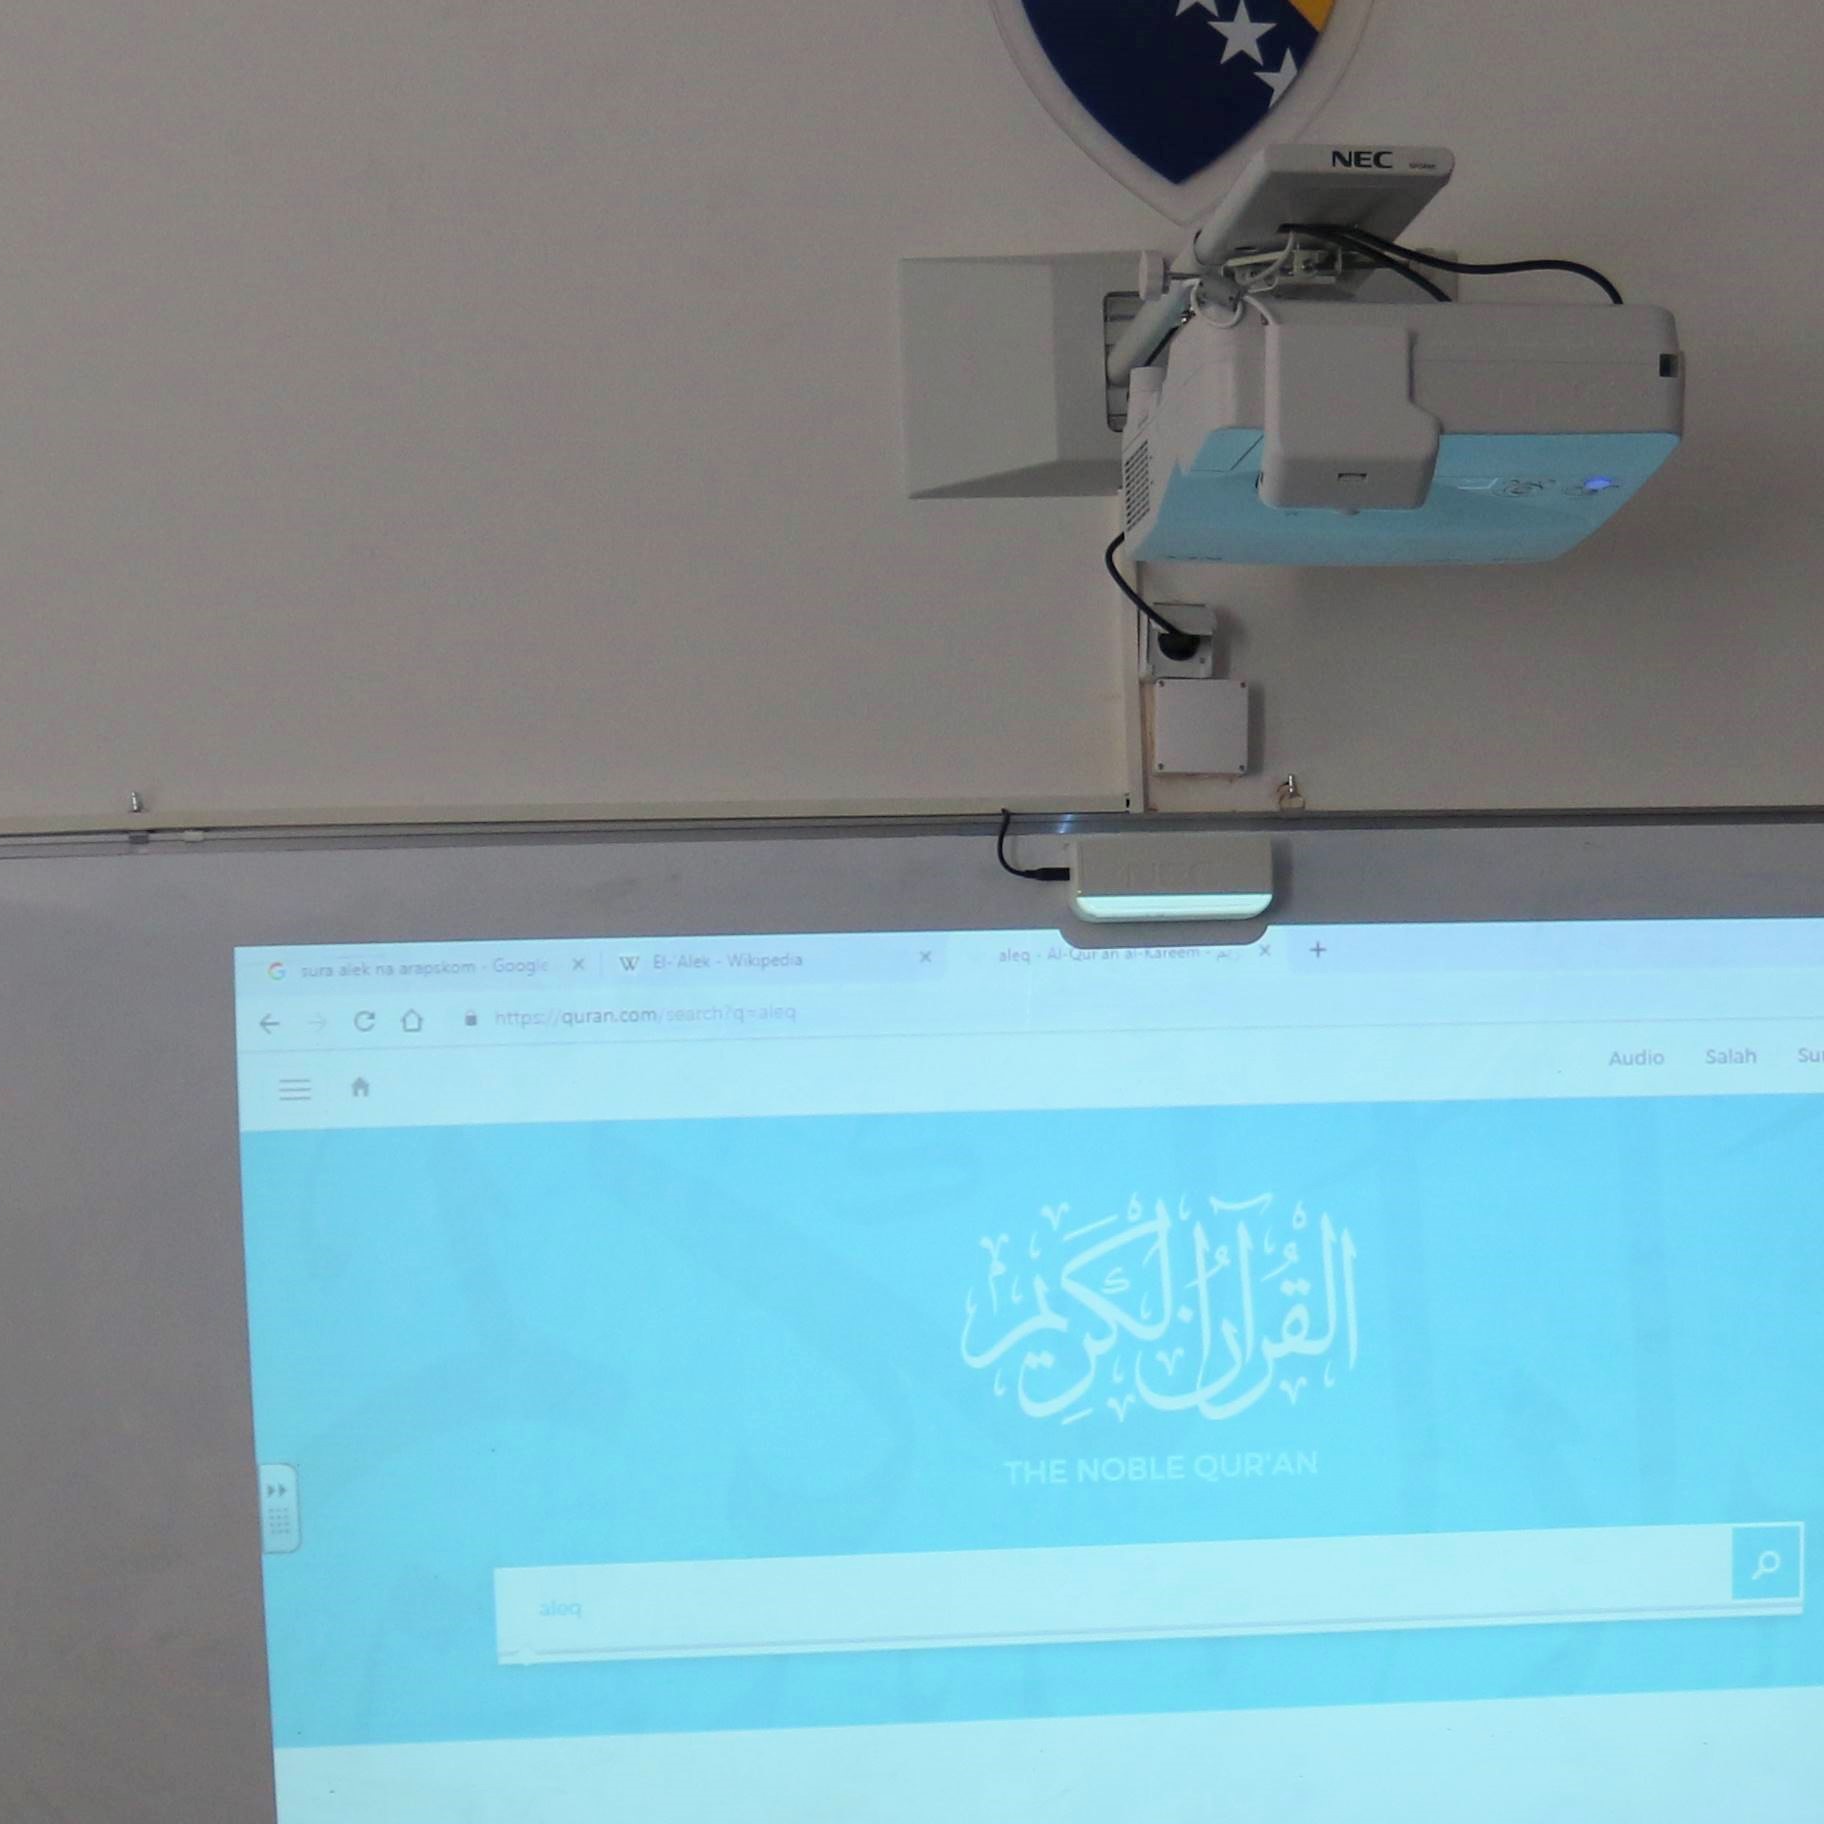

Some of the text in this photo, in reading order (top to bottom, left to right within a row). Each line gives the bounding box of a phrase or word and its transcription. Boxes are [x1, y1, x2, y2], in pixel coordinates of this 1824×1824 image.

[1332, 151, 1393, 168] NEC
[728, 951, 803, 970] Wikipedia
[999, 948, 1031, 964] aleq
[376, 964, 394, 976] na
[1609, 1049, 1665, 1066] Audio
[1705, 1048, 1757, 1064] Salah
[1005, 1450, 1318, 1484] THE NOBLE QUR'AN
[539, 1601, 582, 1617] aleq
